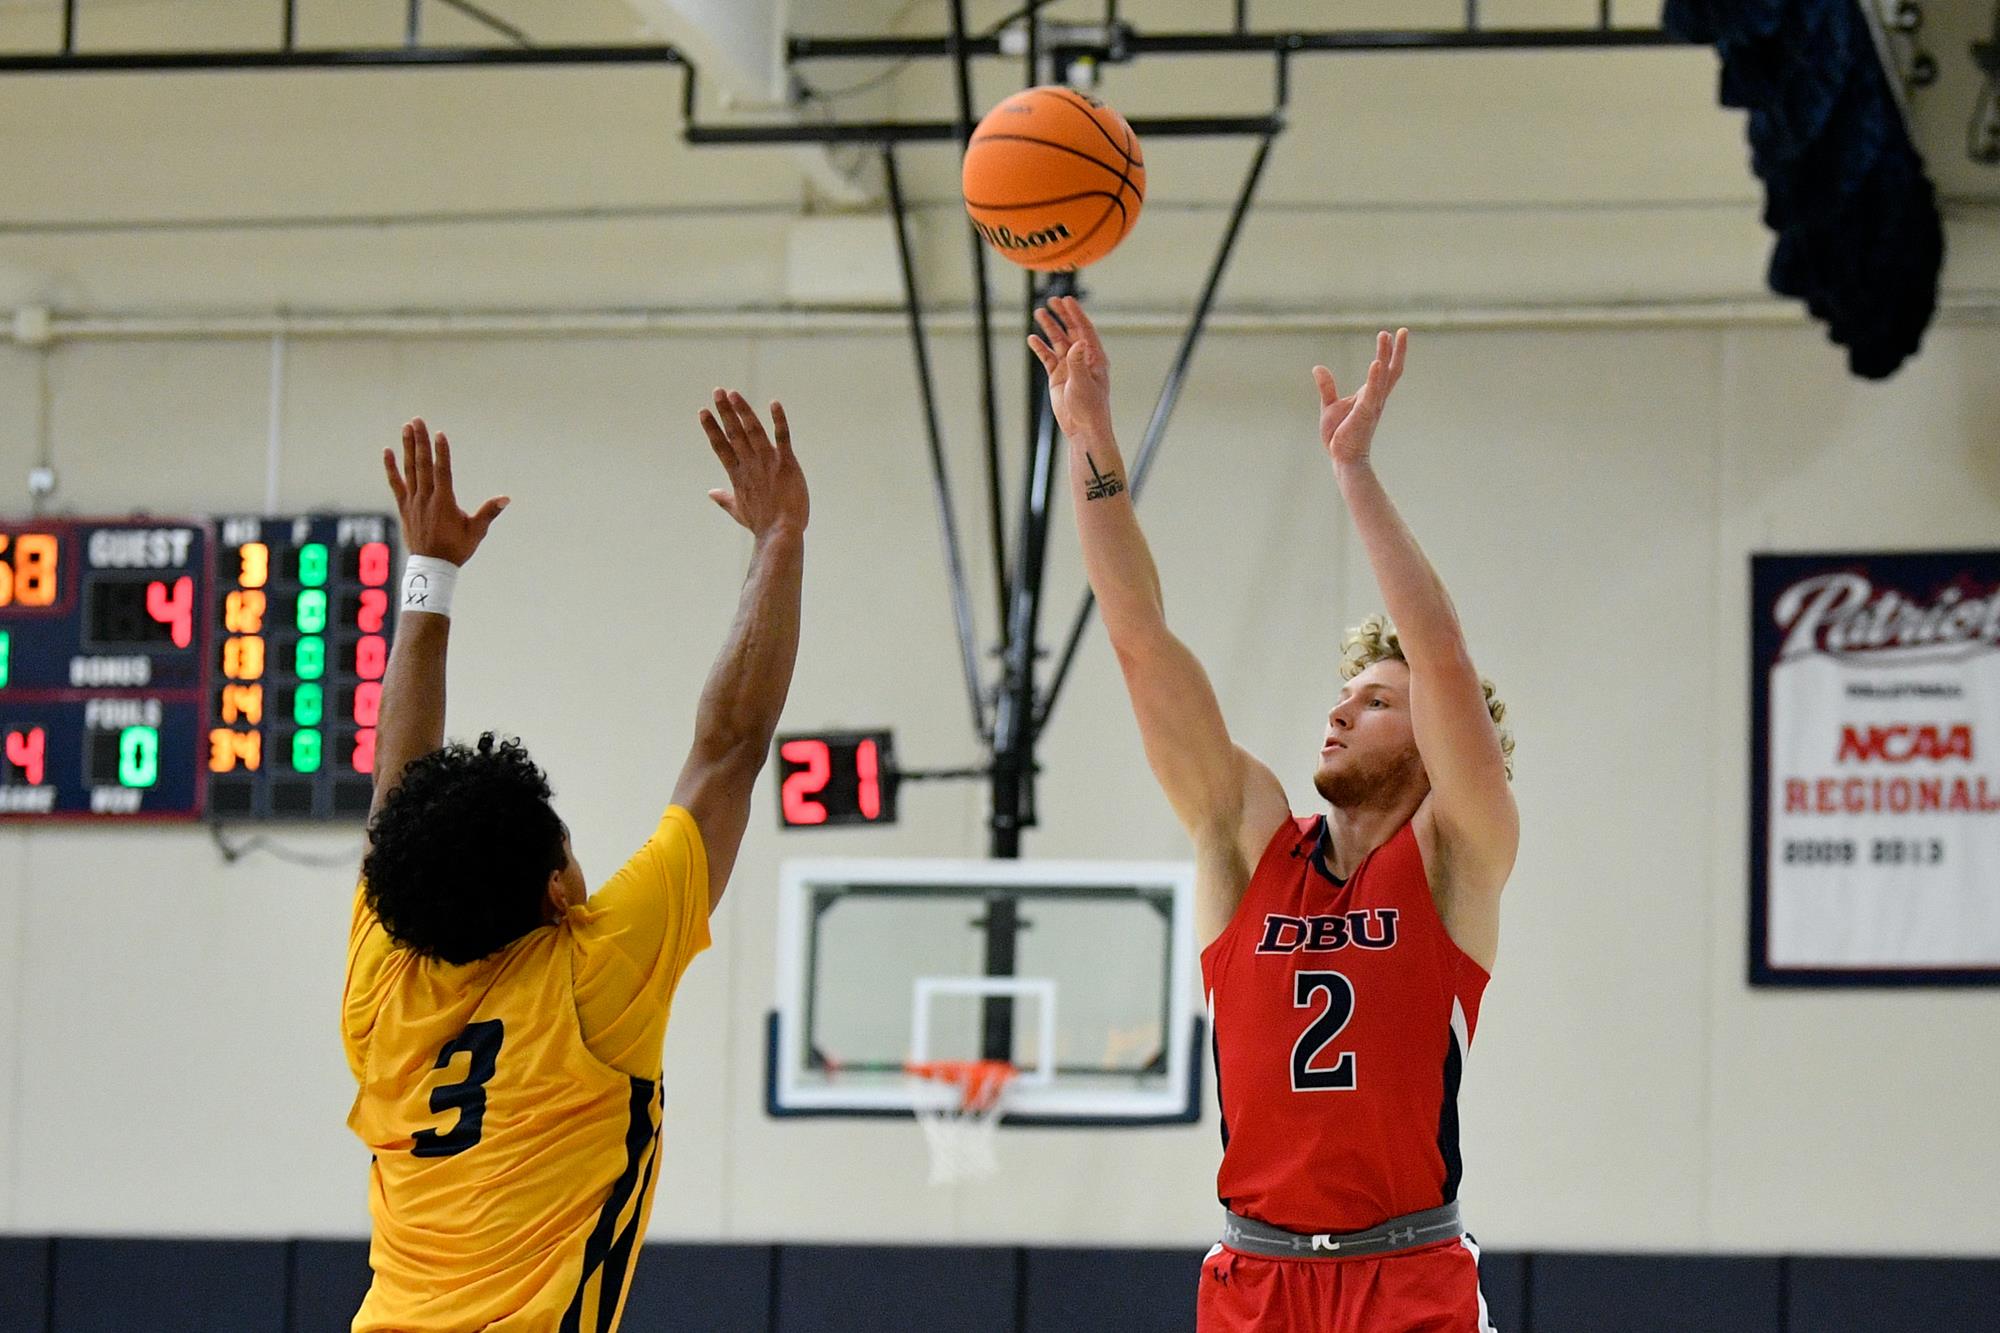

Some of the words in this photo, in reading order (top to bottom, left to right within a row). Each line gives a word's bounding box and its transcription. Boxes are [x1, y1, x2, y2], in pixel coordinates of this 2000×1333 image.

[88, 528, 194, 569] GUEST
[239, 543, 269, 588] 3
[299, 543, 329, 587] 0
[359, 542, 390, 587] 0
[146, 576, 193, 649] 4
[297, 589, 327, 634] 0
[357, 589, 388, 634] 2
[295, 635, 325, 680] 0
[356, 635, 387, 680] 0
[293, 682, 323, 726] 0
[6, 727, 45, 786] 4
[119, 725, 159, 788] 0
[292, 728, 322, 773] 0
[1837, 722, 1973, 765] NCAA
[780, 738, 881, 824] 21
[1785, 776, 2000, 815] REGIONAL
[1255, 908, 1400, 955] DBU
[1289, 970, 1357, 1093] 2
[410, 1018, 504, 1158] 3
